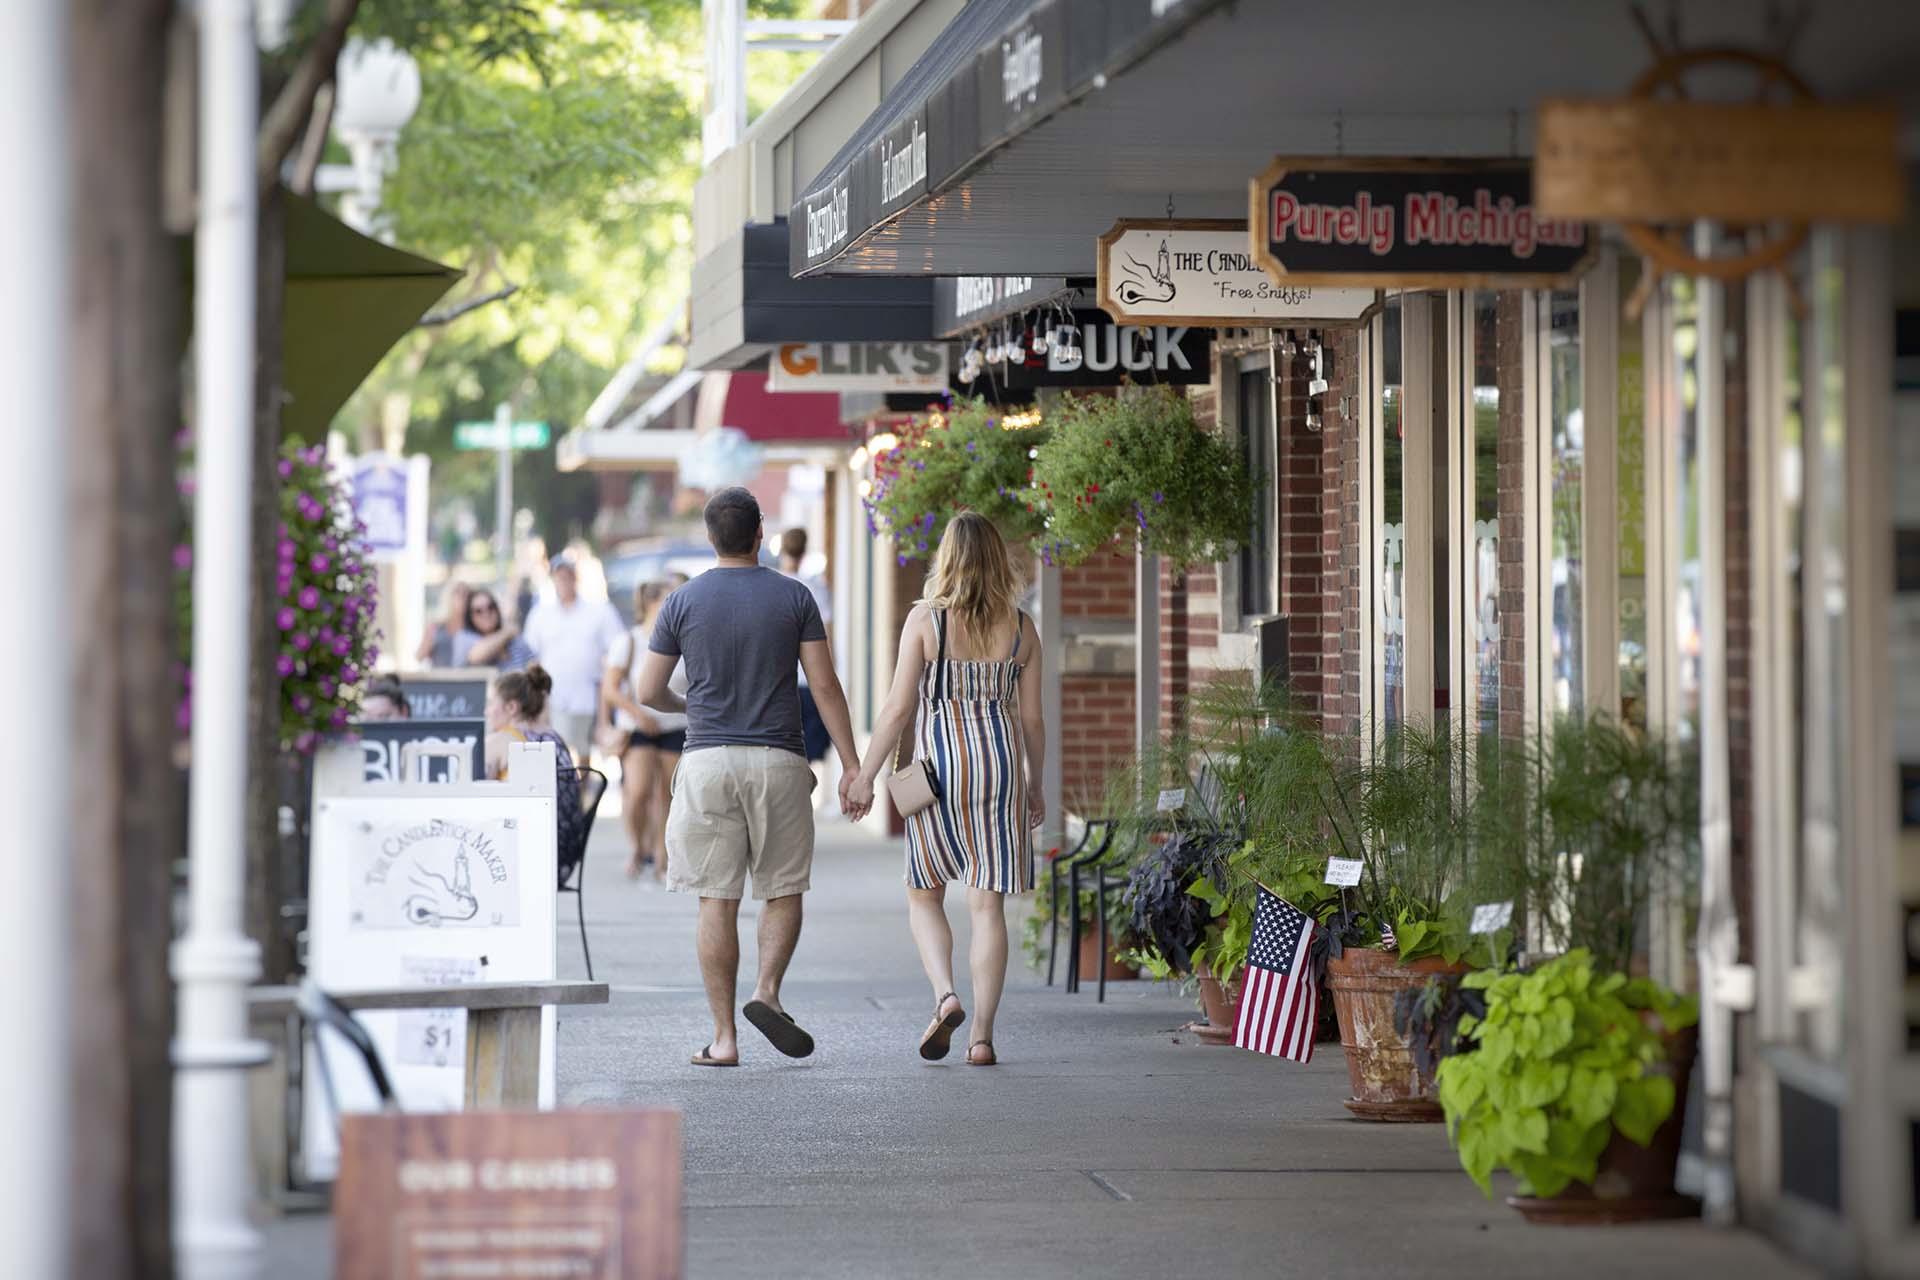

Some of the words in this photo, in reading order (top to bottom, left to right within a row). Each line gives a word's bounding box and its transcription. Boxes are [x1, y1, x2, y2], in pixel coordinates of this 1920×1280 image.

[1271, 190, 1394, 254] Purely
[1404, 190, 1585, 257] Michigan
[1173, 253, 1203, 271] THE
[1207, 250, 1265, 275] CANDL
[779, 342, 942, 376] GLIK'S
[470, 831, 507, 884] MAKER
